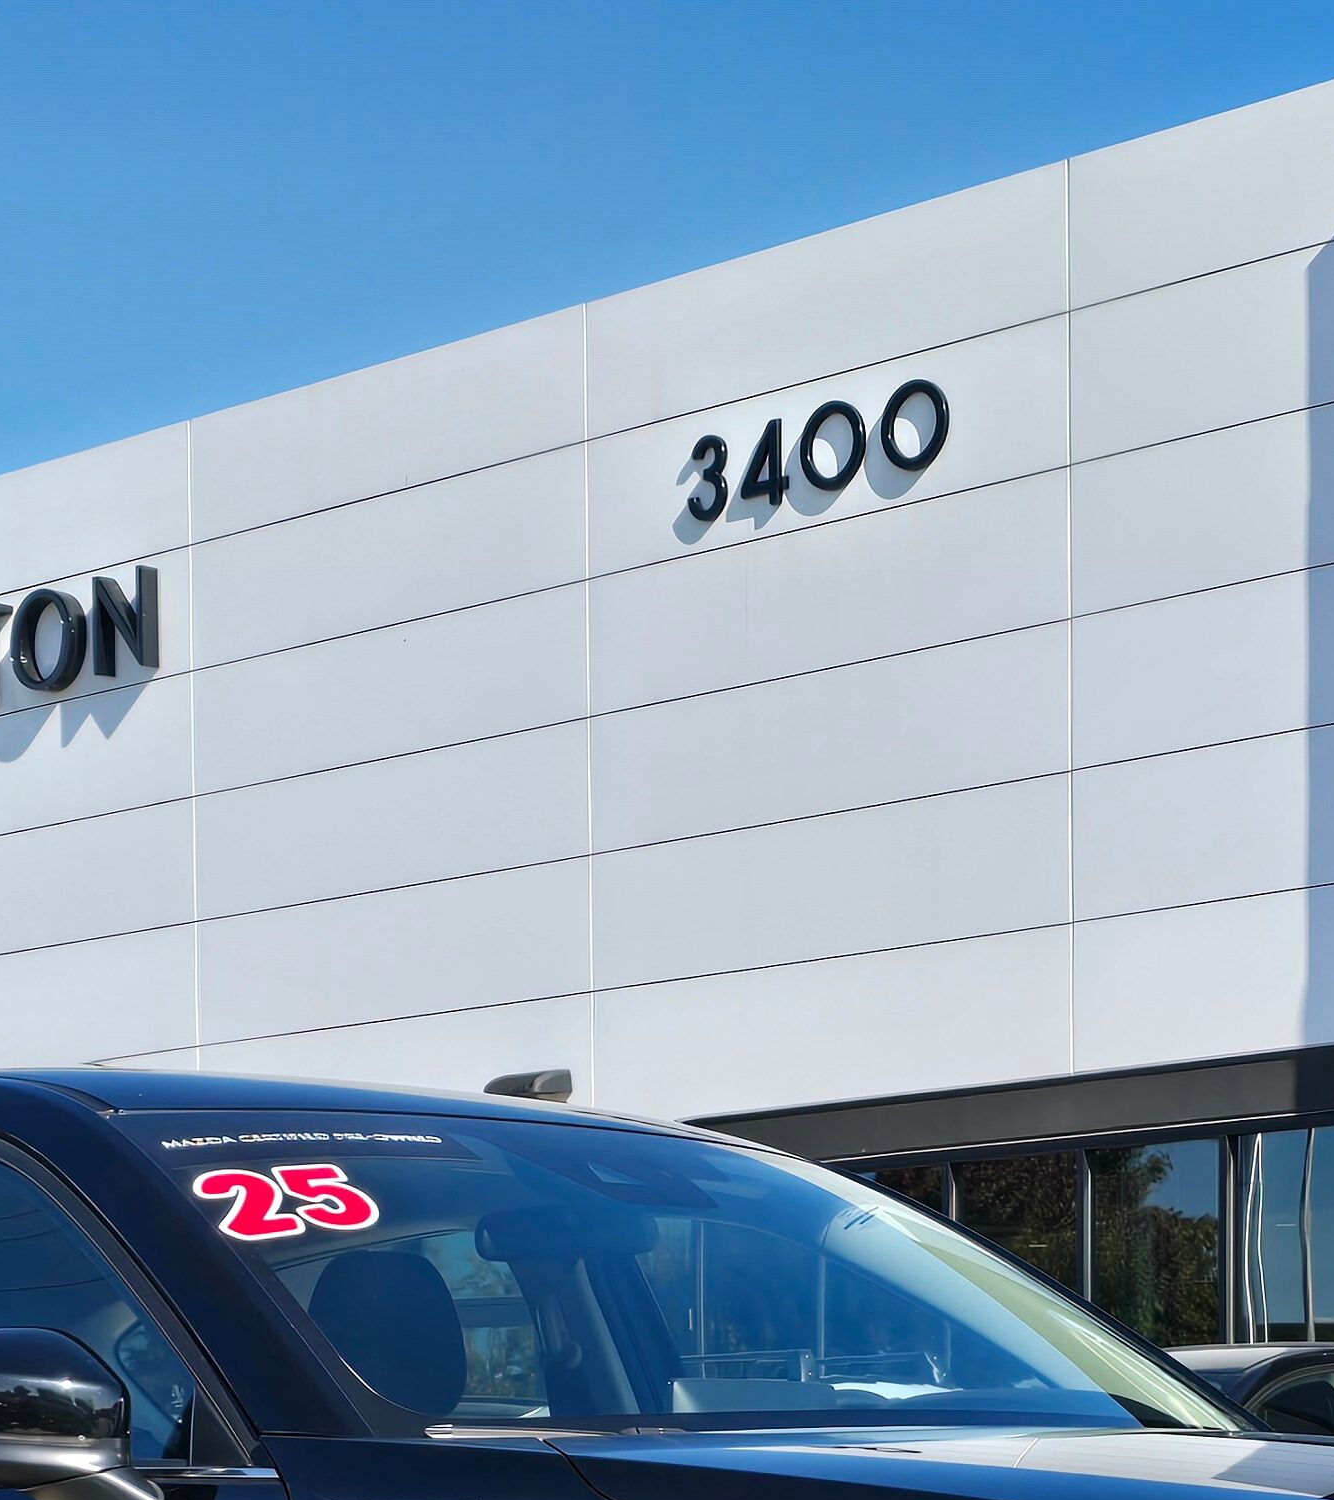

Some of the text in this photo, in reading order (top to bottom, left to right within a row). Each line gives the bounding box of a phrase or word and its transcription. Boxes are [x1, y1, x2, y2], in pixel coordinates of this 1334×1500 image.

[687, 378, 950, 522] 3400
[161, 1134, 237, 1150] MAZDA
[192, 1163, 380, 1241] 25
